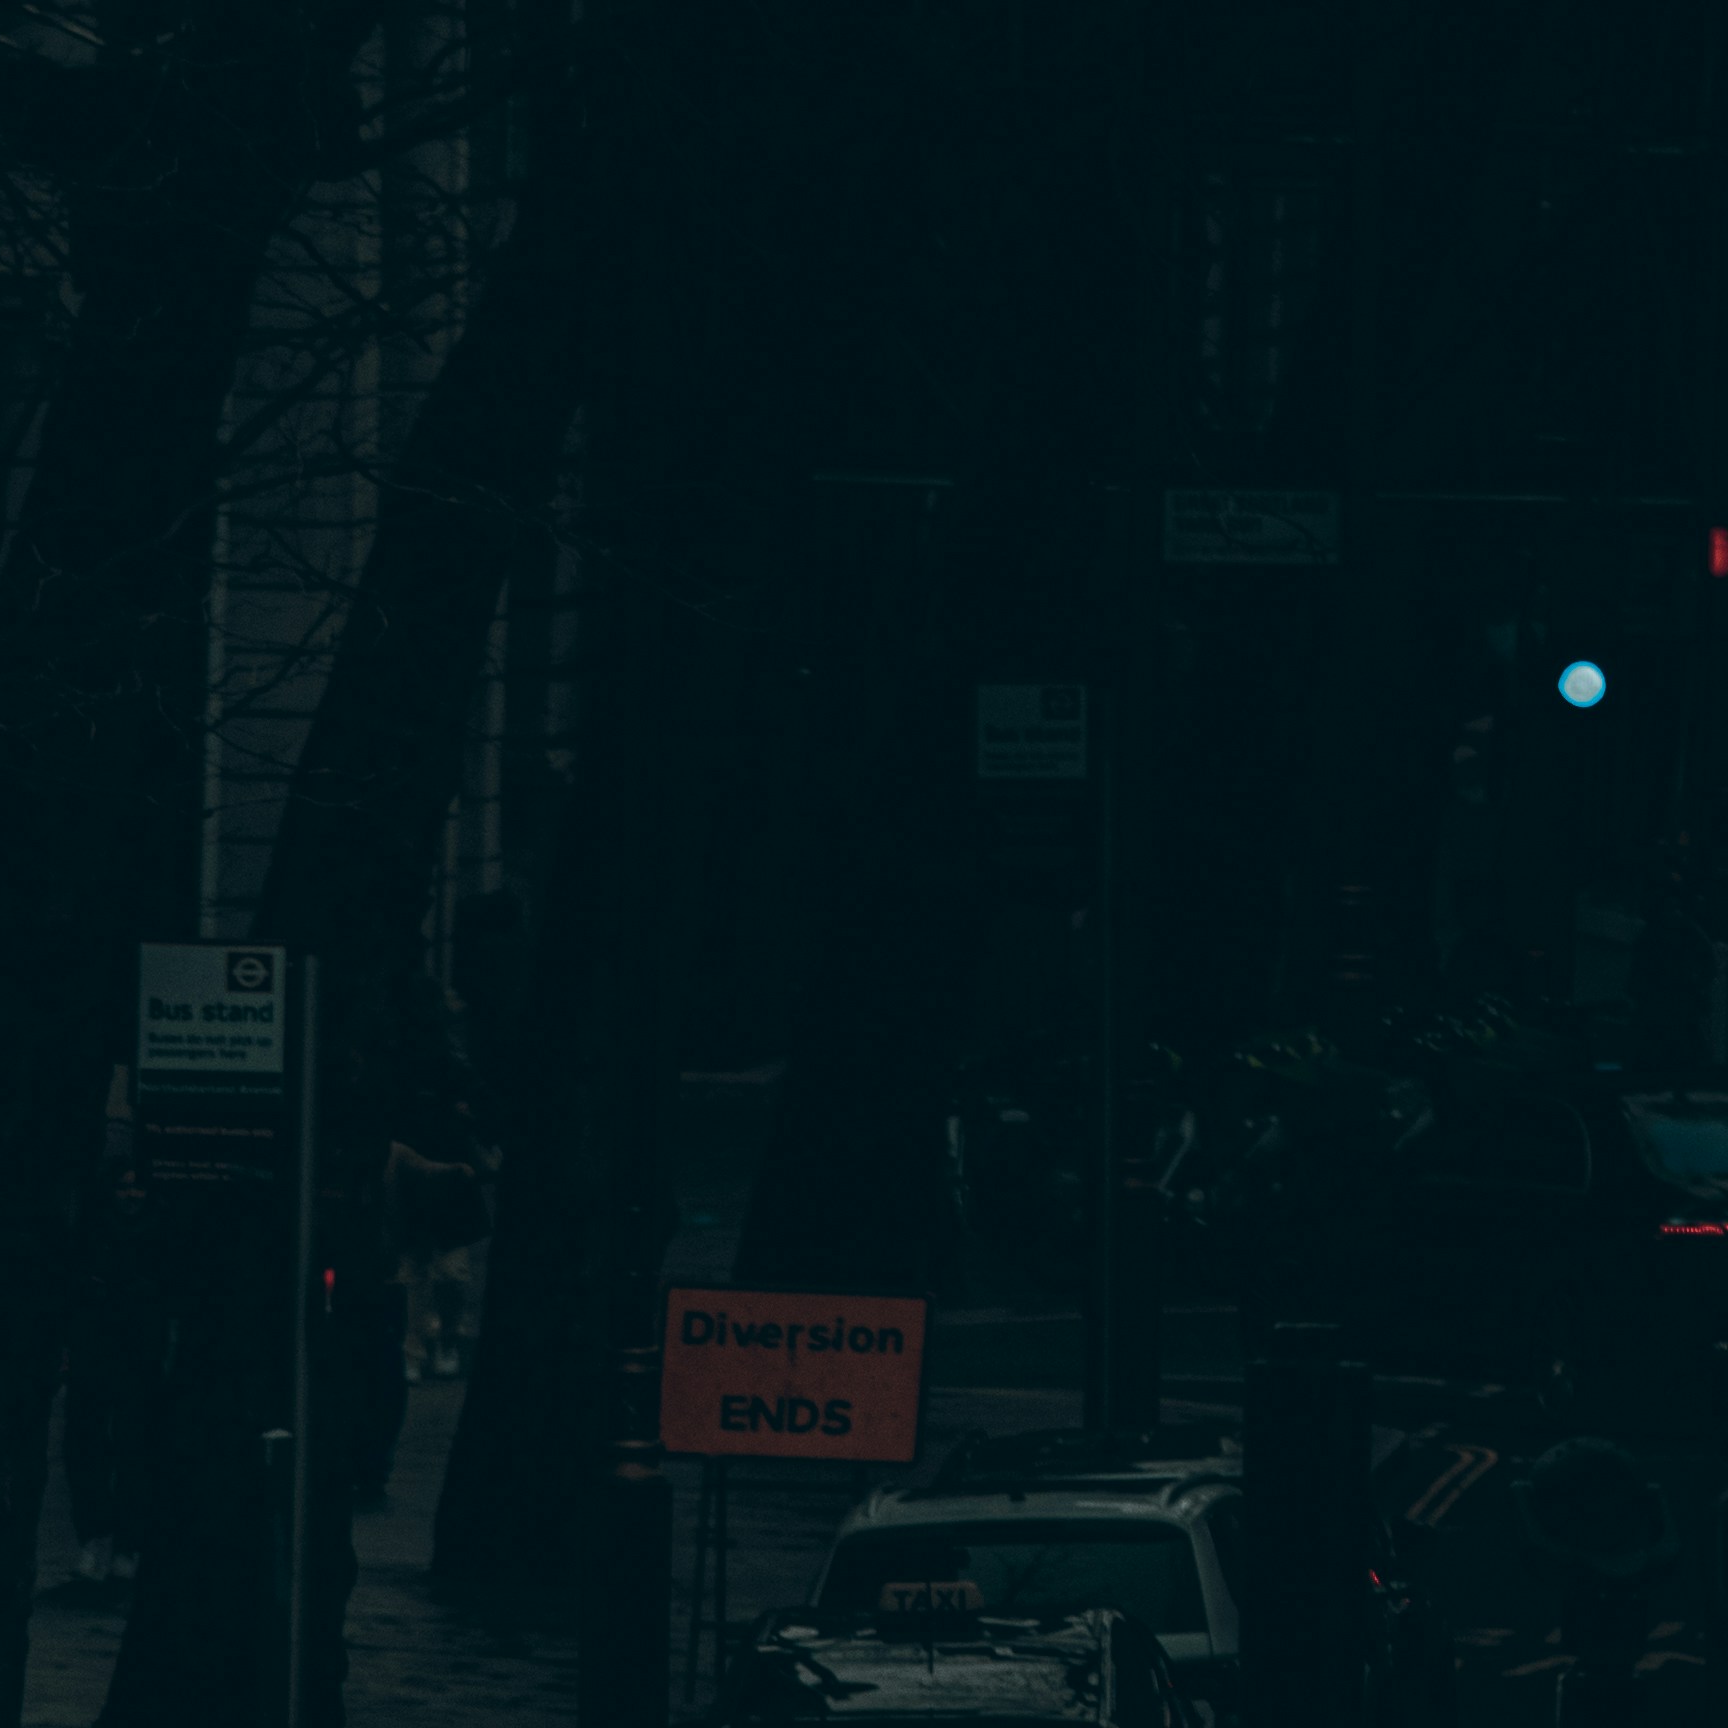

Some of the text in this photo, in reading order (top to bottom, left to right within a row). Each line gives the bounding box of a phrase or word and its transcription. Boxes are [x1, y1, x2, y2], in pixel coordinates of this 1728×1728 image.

[149, 997, 273, 1023] Bus stand
[682, 1310, 904, 1355] Diversion
[720, 1395, 853, 1435] ENDS
[894, 1589, 967, 1611] TAXI
